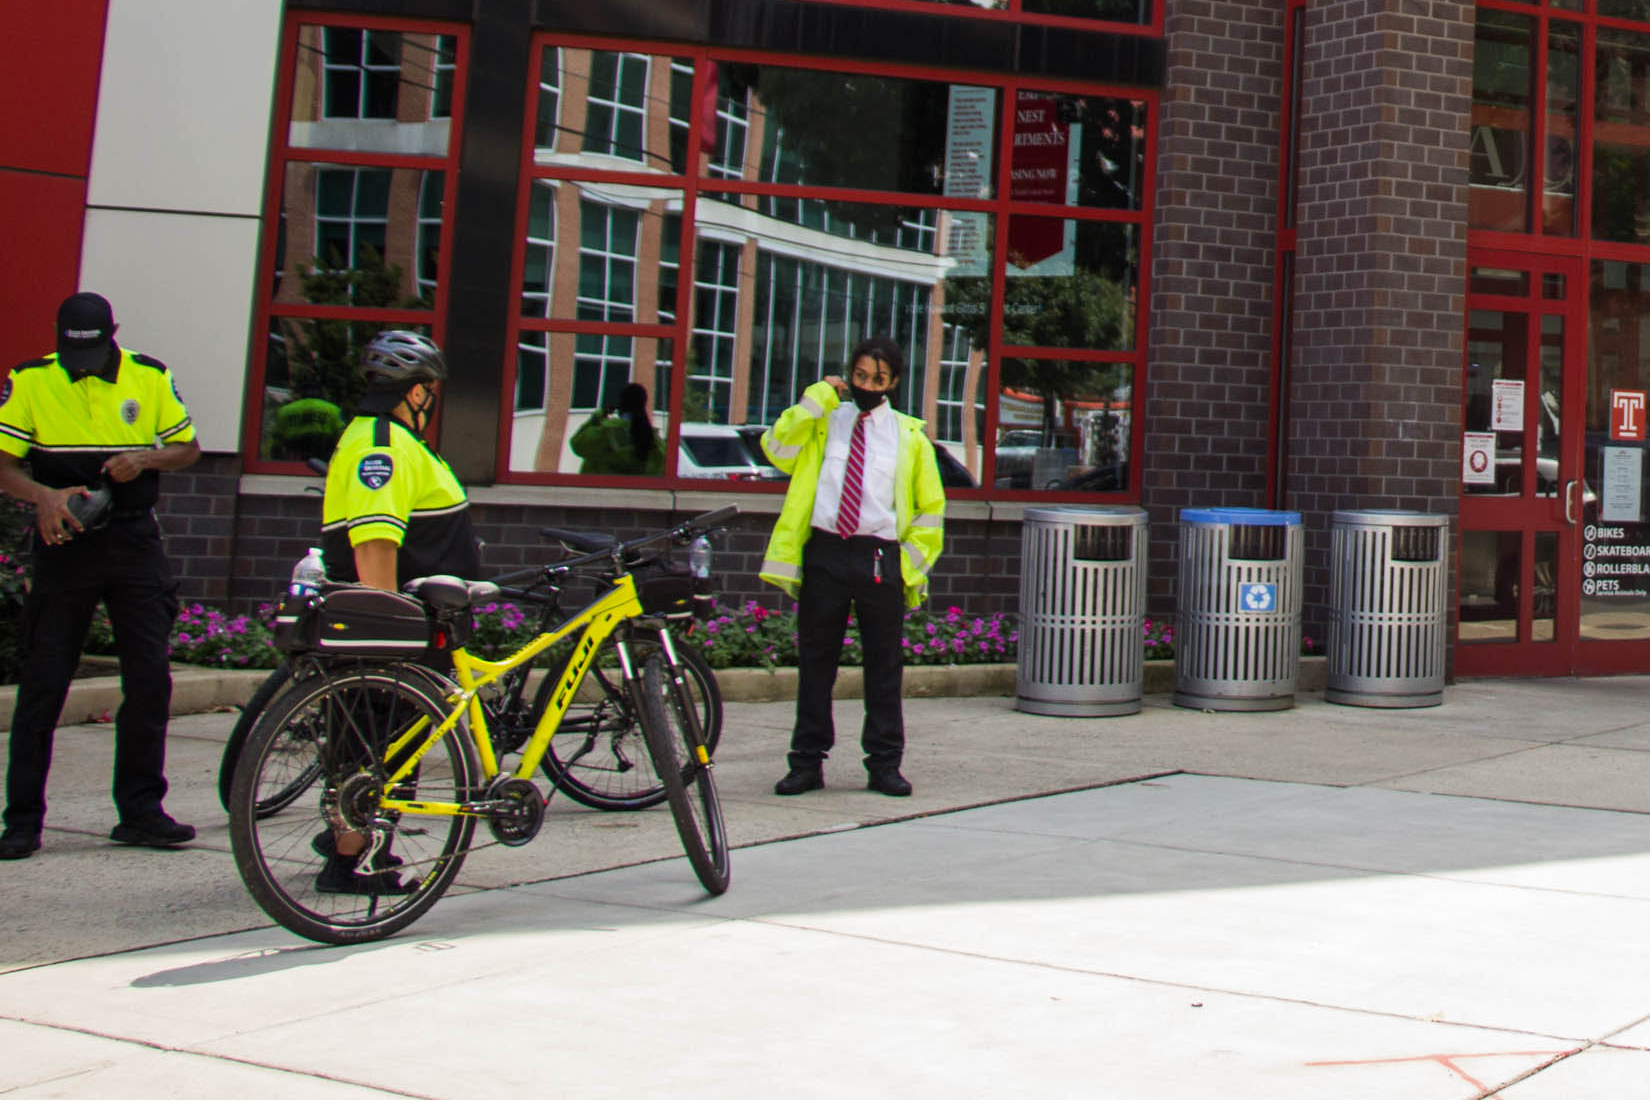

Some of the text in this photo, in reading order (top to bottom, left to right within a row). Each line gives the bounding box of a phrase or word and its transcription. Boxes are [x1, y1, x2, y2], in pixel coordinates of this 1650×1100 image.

[1017, 109, 1046, 124] NEST
[1014, 132, 1065, 147] RTMENTS
[1597, 527, 1624, 539] BIKES
[1596, 579, 1620, 591] PETS
[555, 636, 594, 711] FUJI
